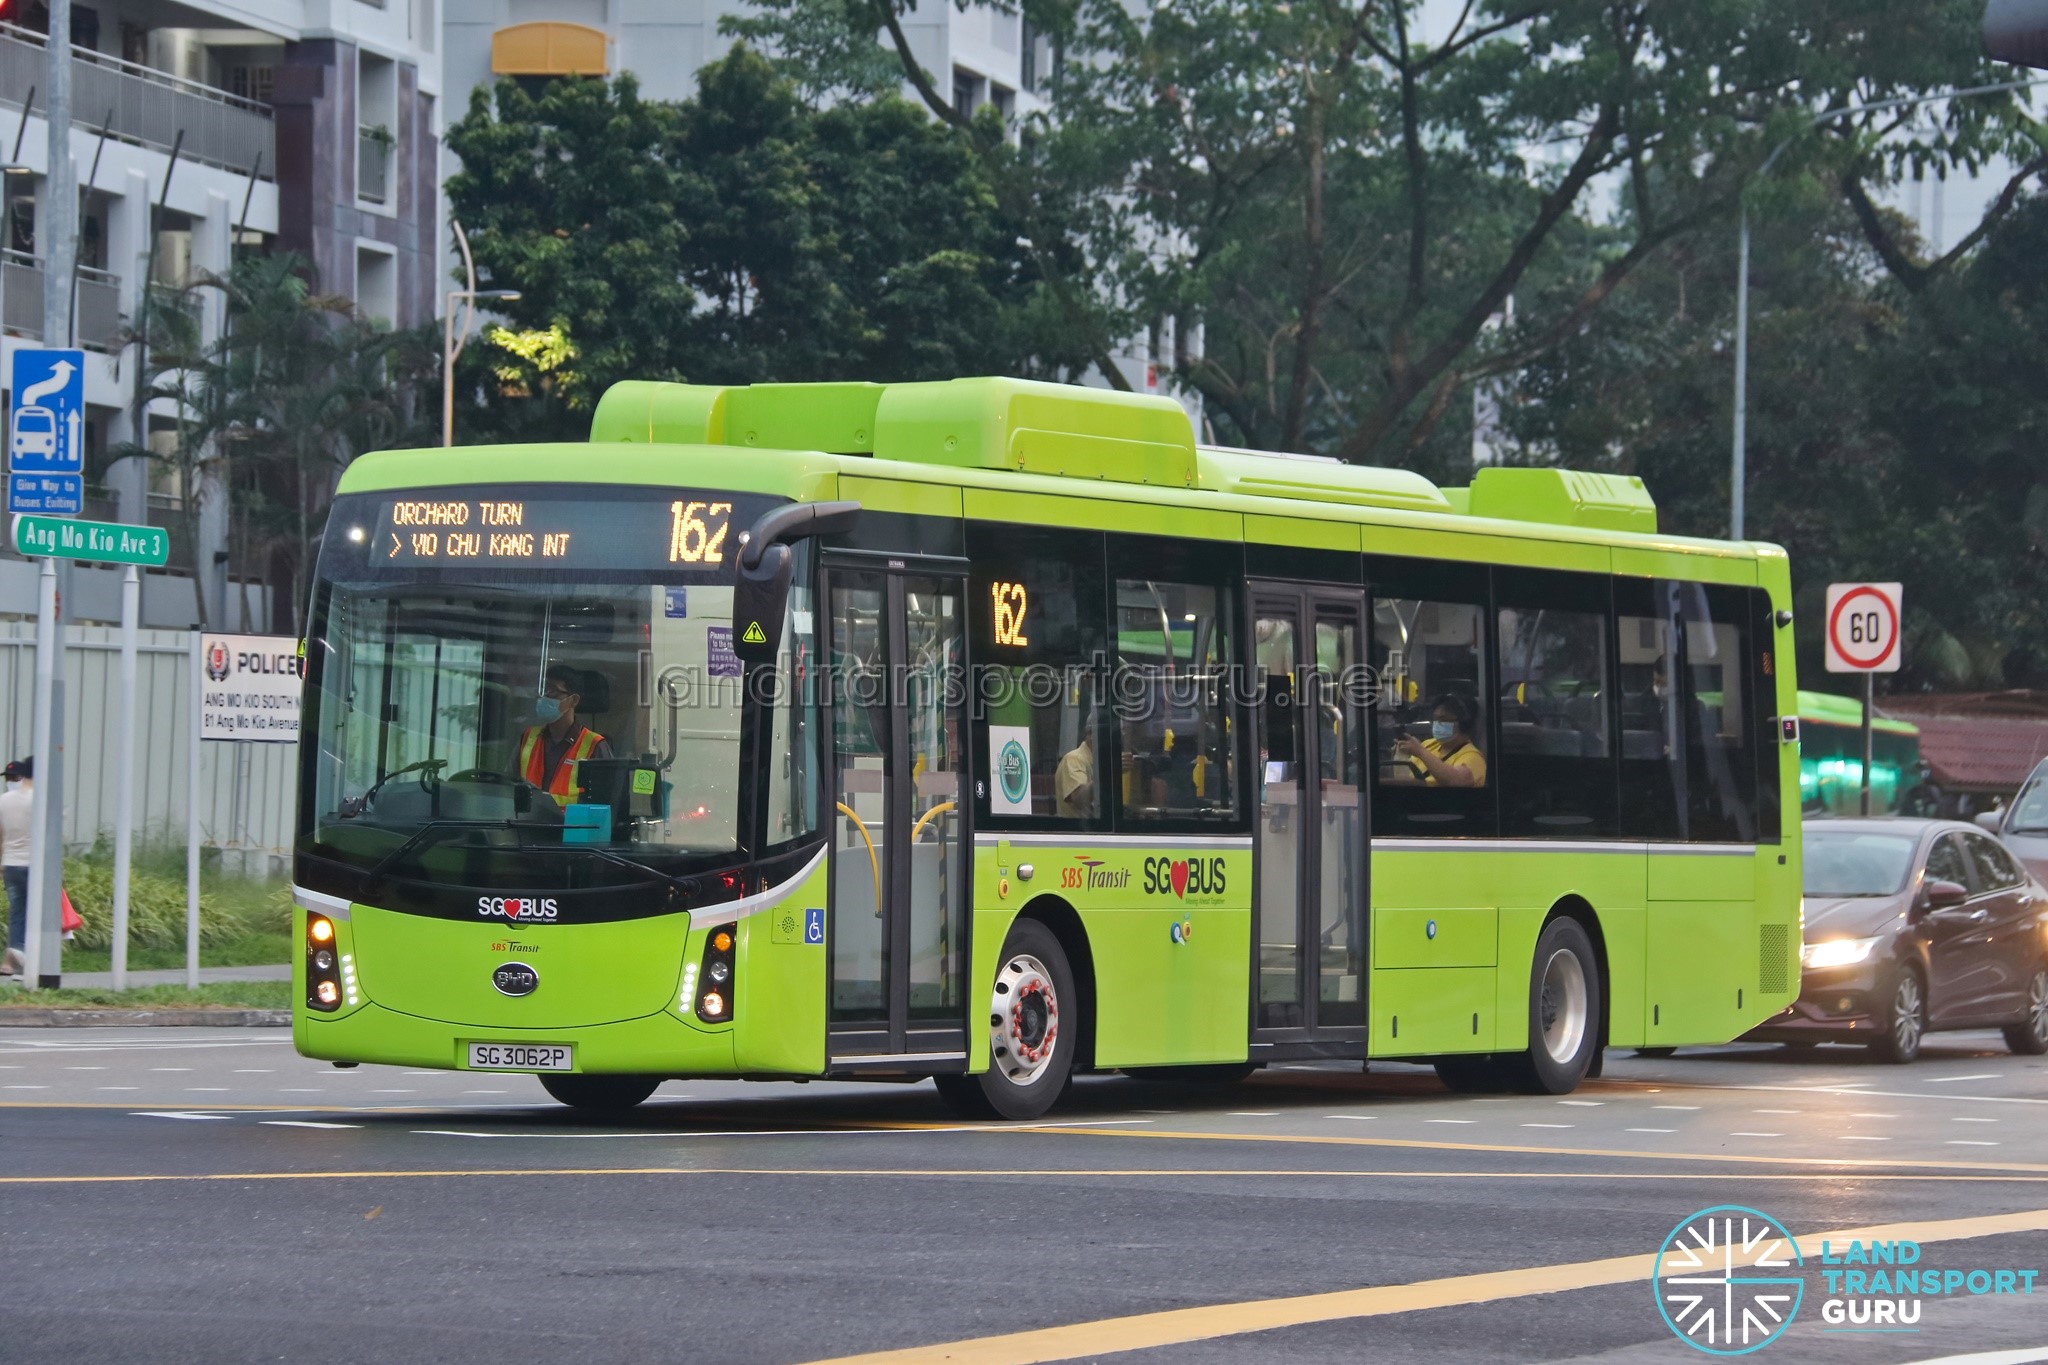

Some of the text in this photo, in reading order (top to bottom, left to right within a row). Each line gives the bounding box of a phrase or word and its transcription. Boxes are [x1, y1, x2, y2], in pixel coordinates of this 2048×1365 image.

[16, 479, 75, 494] Give Way to
[14, 496, 41, 507] Buses
[393, 502, 523, 526] ORCHARD TURN
[25, 521, 160, 556] Ang Mo Kio Ave 3
[669, 500, 732, 563] 162
[411, 533, 570, 557] YIO CHU KANG INT
[991, 581, 1028, 646] 162
[1851, 612, 1879, 643] 60
[237, 652, 296, 675] POLICE
[205, 692, 224, 707] ANG
[227, 693, 241, 708] MO
[245, 694, 260, 708] KIO
[262, 695, 293, 709] SOUTH
[217, 714, 234, 732] Ang
[237, 714, 249, 728] Mo
[252, 715, 265, 729] Kio
[269, 716, 298, 730] Avenue
[1008, 754, 1020, 766] Bus
[1061, 861, 1132, 893] SBS Transit
[1187, 857, 1226, 895] BUS
[520, 898, 558, 917] BUS
[491, 941, 539, 953] SBS Transit
[497, 971, 533, 987] BYD
